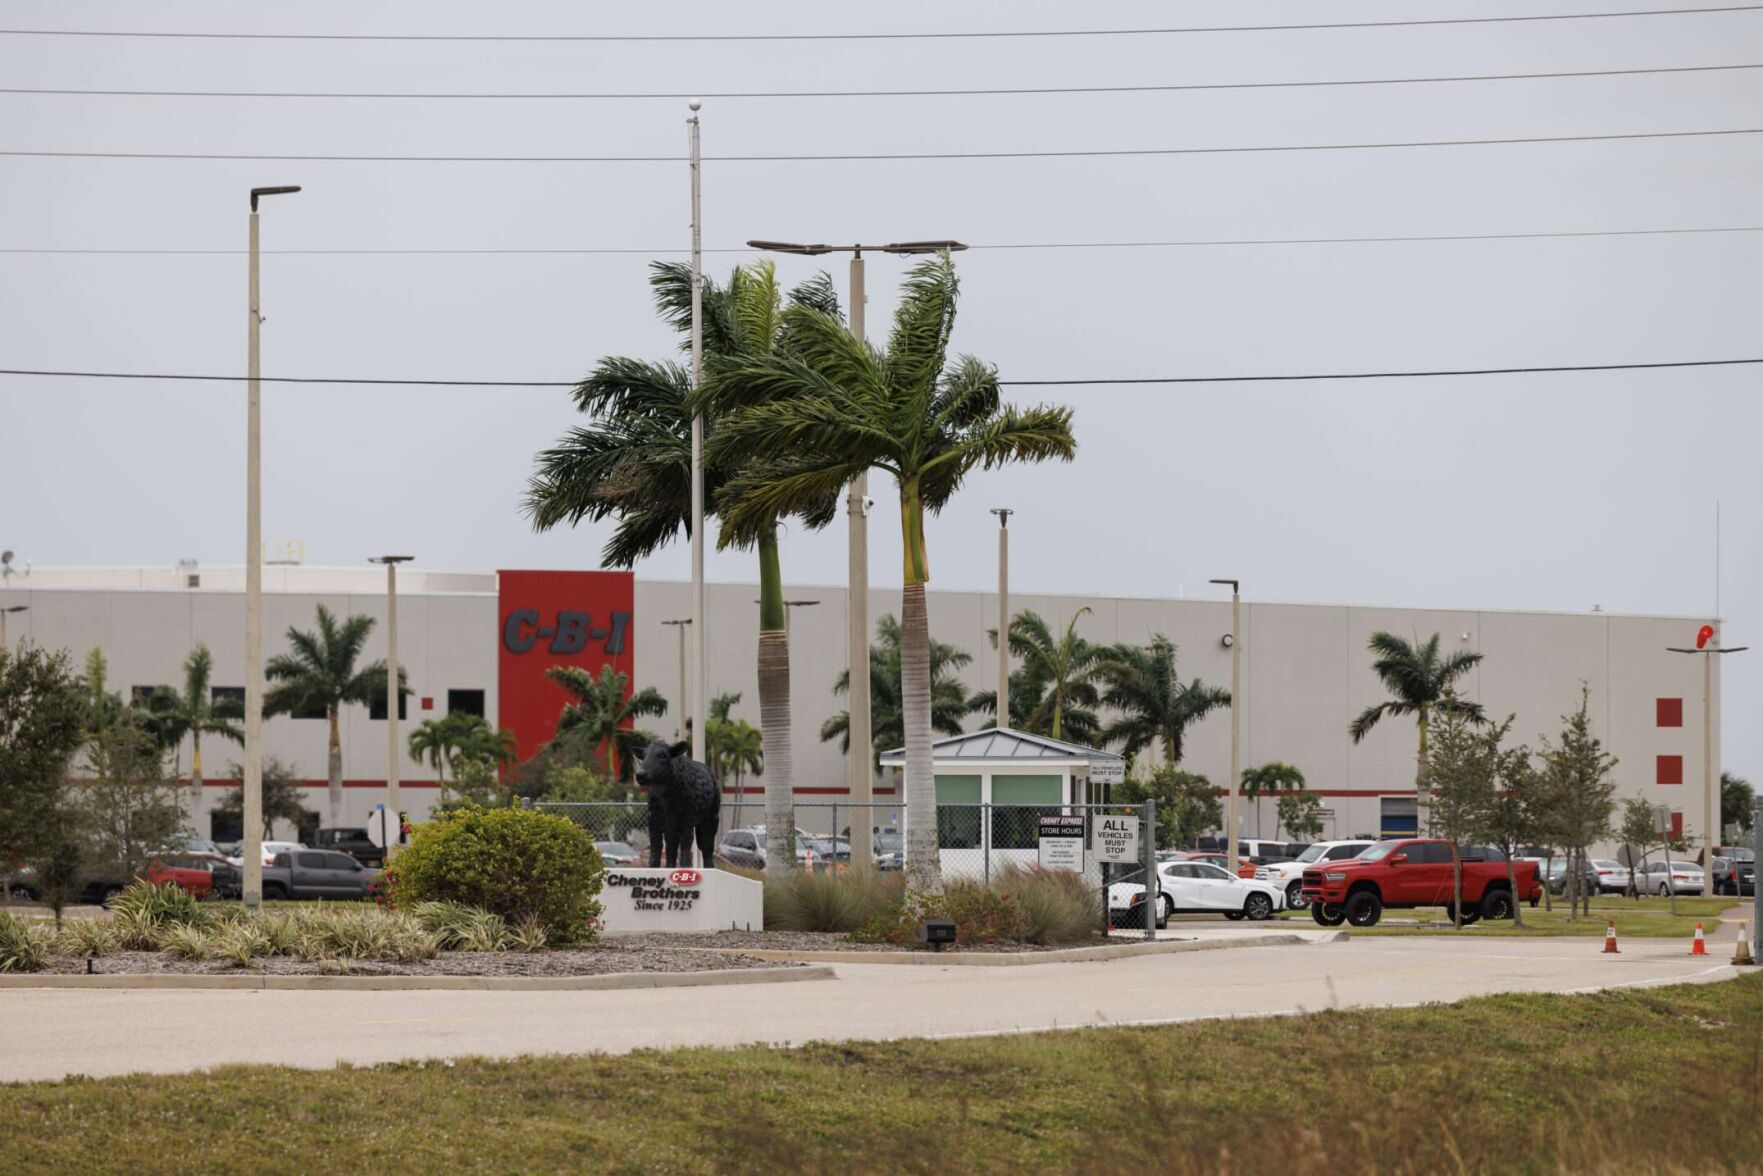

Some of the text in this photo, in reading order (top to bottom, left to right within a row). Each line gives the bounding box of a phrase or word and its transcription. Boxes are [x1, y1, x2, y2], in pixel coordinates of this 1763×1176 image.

[504, 609, 631, 655] C-B-I
[1103, 820, 1128, 831] ALL
[1097, 832, 1134, 840] VEHICLES
[1105, 846, 1125, 854] STOP
[607, 874, 666, 888] Cheney
[631, 887, 700, 899] Brothers
[634, 900, 692, 910] Since 1925
